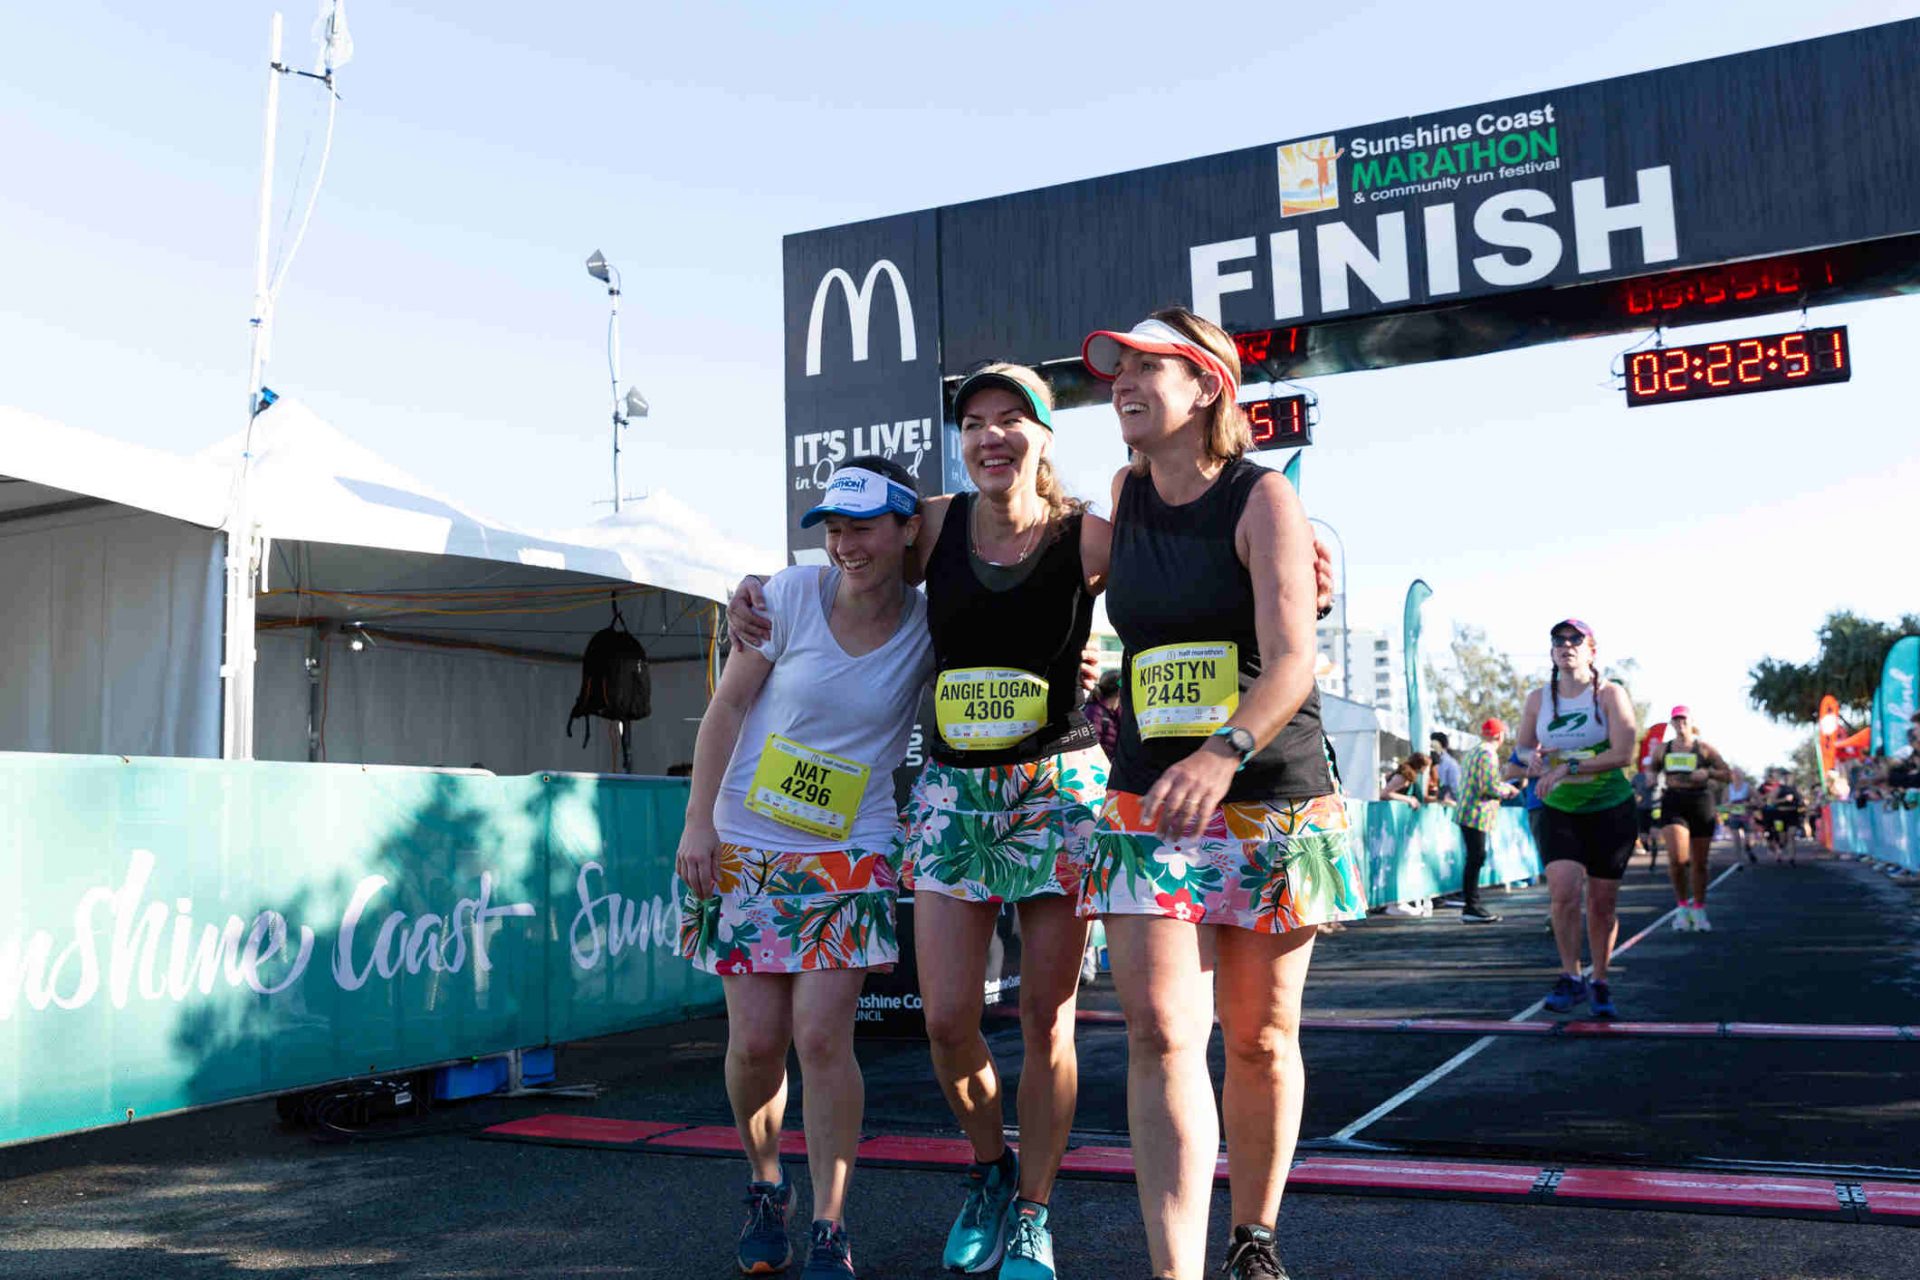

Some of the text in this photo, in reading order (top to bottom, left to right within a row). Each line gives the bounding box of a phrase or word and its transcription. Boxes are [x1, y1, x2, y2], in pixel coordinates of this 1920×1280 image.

[1350, 102, 1556, 159] Sunshine Coast
[1352, 126, 1558, 193] MARATHON
[1353, 156, 1561, 205] & community run festival
[1189, 165, 1679, 329] FINISH
[1632, 332, 1843, 395] 02:22:51
[794, 429, 846, 468] IT'S
[853, 418, 932, 458] LIVE!
[795, 476, 811, 490] in
[1140, 660, 1216, 687] KIRSTYN
[940, 680, 1041, 701] ANGIE LOGAN
[1147, 682, 1201, 707] 2445
[964, 700, 1015, 720] 4306
[793, 760, 831, 785] NAT
[780, 776, 832, 807] 4296
[570, 861, 683, 970] Suns
[0, 849, 537, 1021] nshine Coast
[855, 1010, 884, 1022] UNCIL
[857, 993, 901, 1009] nshine
